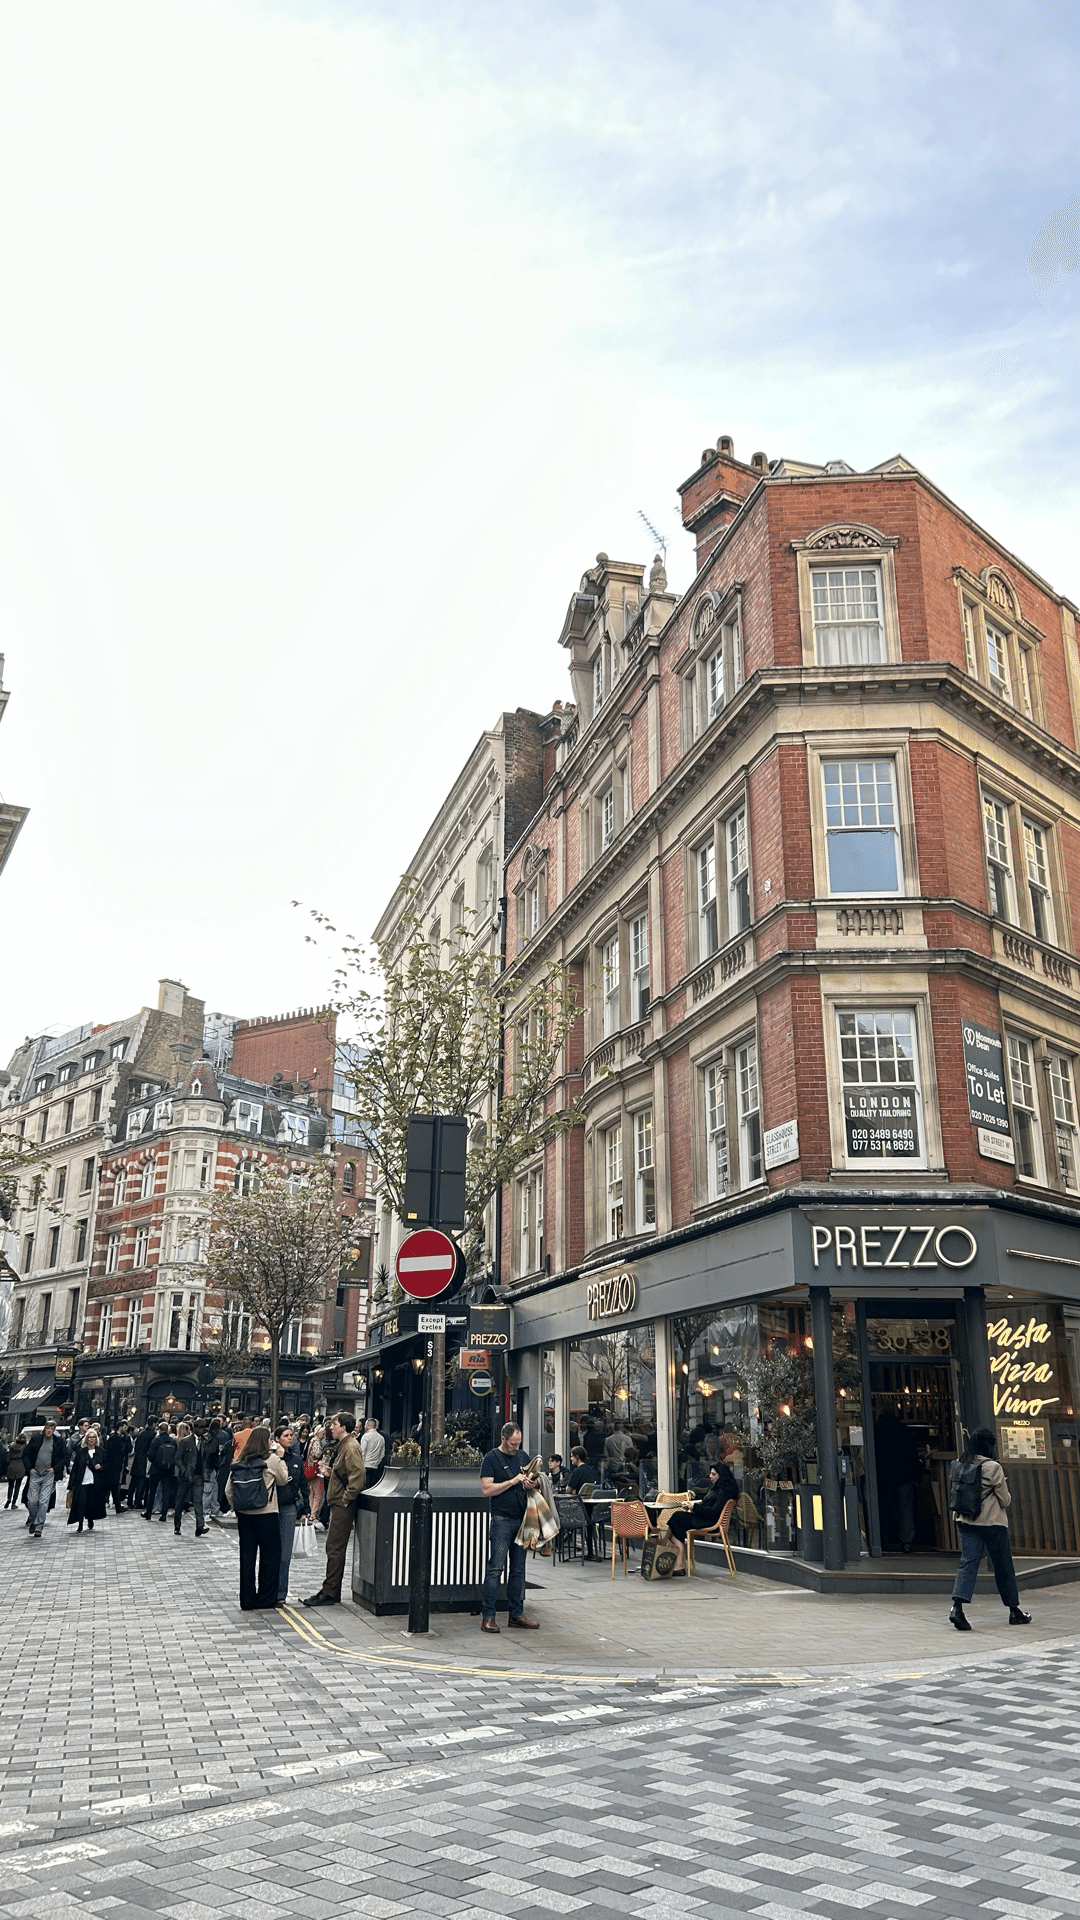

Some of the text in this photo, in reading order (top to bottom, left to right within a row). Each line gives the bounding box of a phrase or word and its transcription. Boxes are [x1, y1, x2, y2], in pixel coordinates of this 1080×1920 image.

[975, 1031, 1002, 1048] Monmouth
[976, 1040, 990, 1051] Dean
[967, 1062, 1000, 1081] Office Suites
[968, 1075, 1005, 1105] To Let
[849, 1096, 911, 1108] LONDON
[850, 1109, 912, 1117] QUALITY TAILORING
[971, 1109, 981, 1120] 020
[982, 1113, 996, 1124] 7025
[852, 1129, 913, 1139] 020 3489 6490
[991, 1136, 1005, 1147] STREET
[767, 1141, 782, 1156] STREET
[853, 1140, 914, 1150] 077 5314 8629
[811, 1224, 978, 1268] PREZZO
[587, 1273, 636, 1320] PREZZO
[421, 1316, 443, 1324] Except
[470, 1333, 508, 1345] PREZZO
[986, 1318, 1052, 1350] Pasta
[427, 1340, 434, 1349] S
[988, 1351, 1054, 1385] Pizza
[992, 1383, 1061, 1416] Vino
